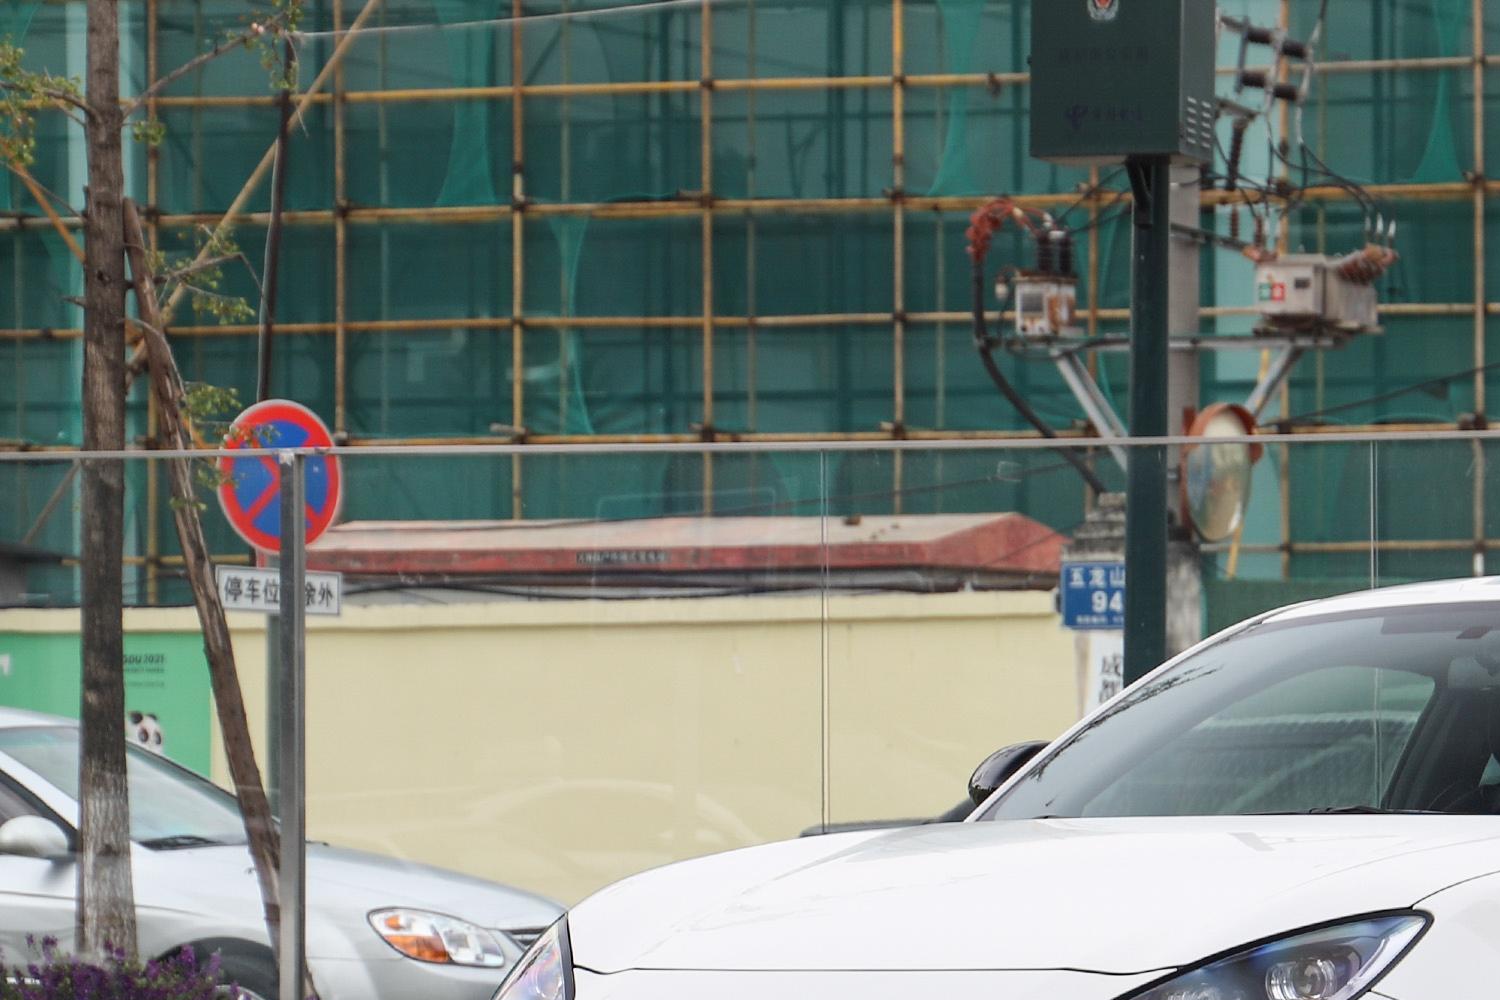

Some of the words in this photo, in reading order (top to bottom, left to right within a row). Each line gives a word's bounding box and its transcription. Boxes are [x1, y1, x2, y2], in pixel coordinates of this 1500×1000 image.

[224, 575, 334, 607] 停车位除外
